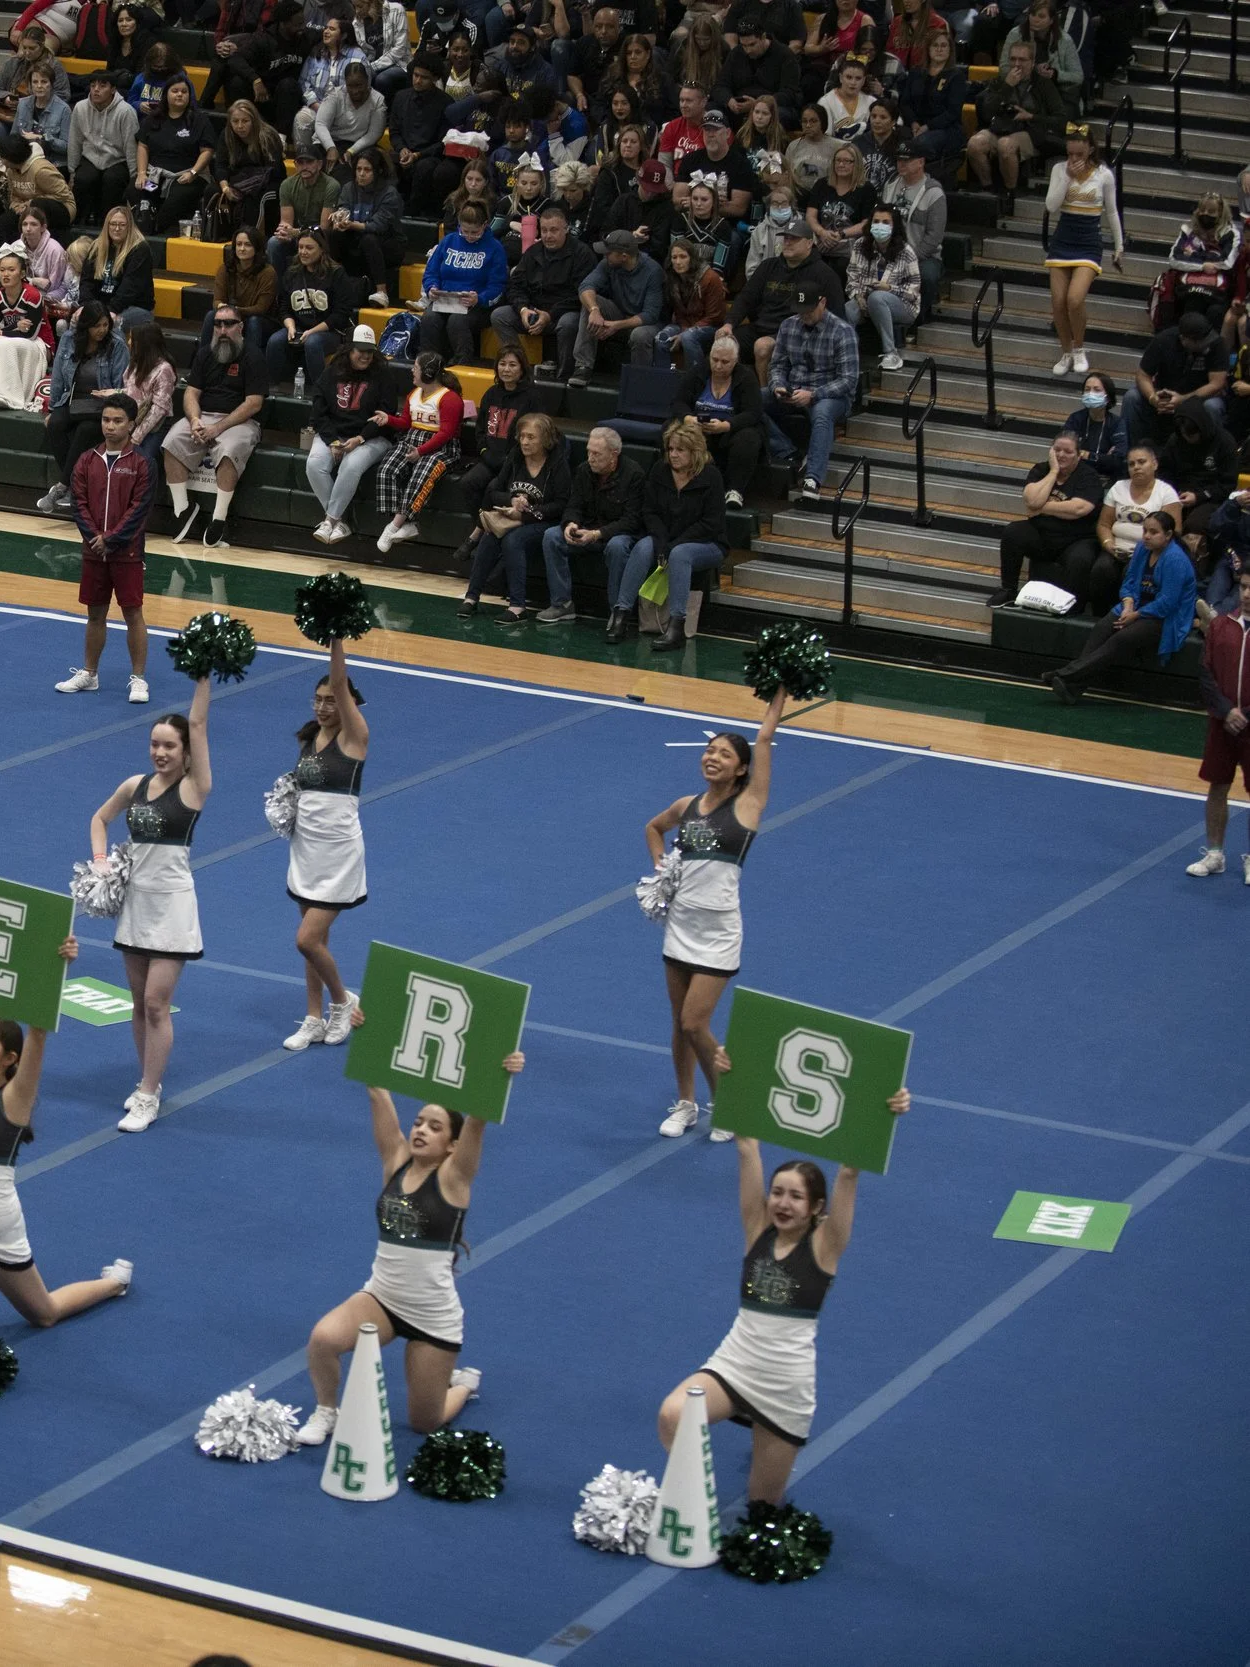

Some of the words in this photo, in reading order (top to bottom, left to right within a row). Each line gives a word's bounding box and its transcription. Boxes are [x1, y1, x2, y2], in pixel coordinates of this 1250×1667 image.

[653, 172, 661, 183] B
[444, 247, 486, 269] TCHS
[798, 292, 806, 303] B
[390, 971, 473, 1089] R
[767, 1027, 853, 1138] S
[1027, 1200, 1095, 1239] KICK
[331, 1441, 368, 1493] PC
[657, 1506, 694, 1557] PC
